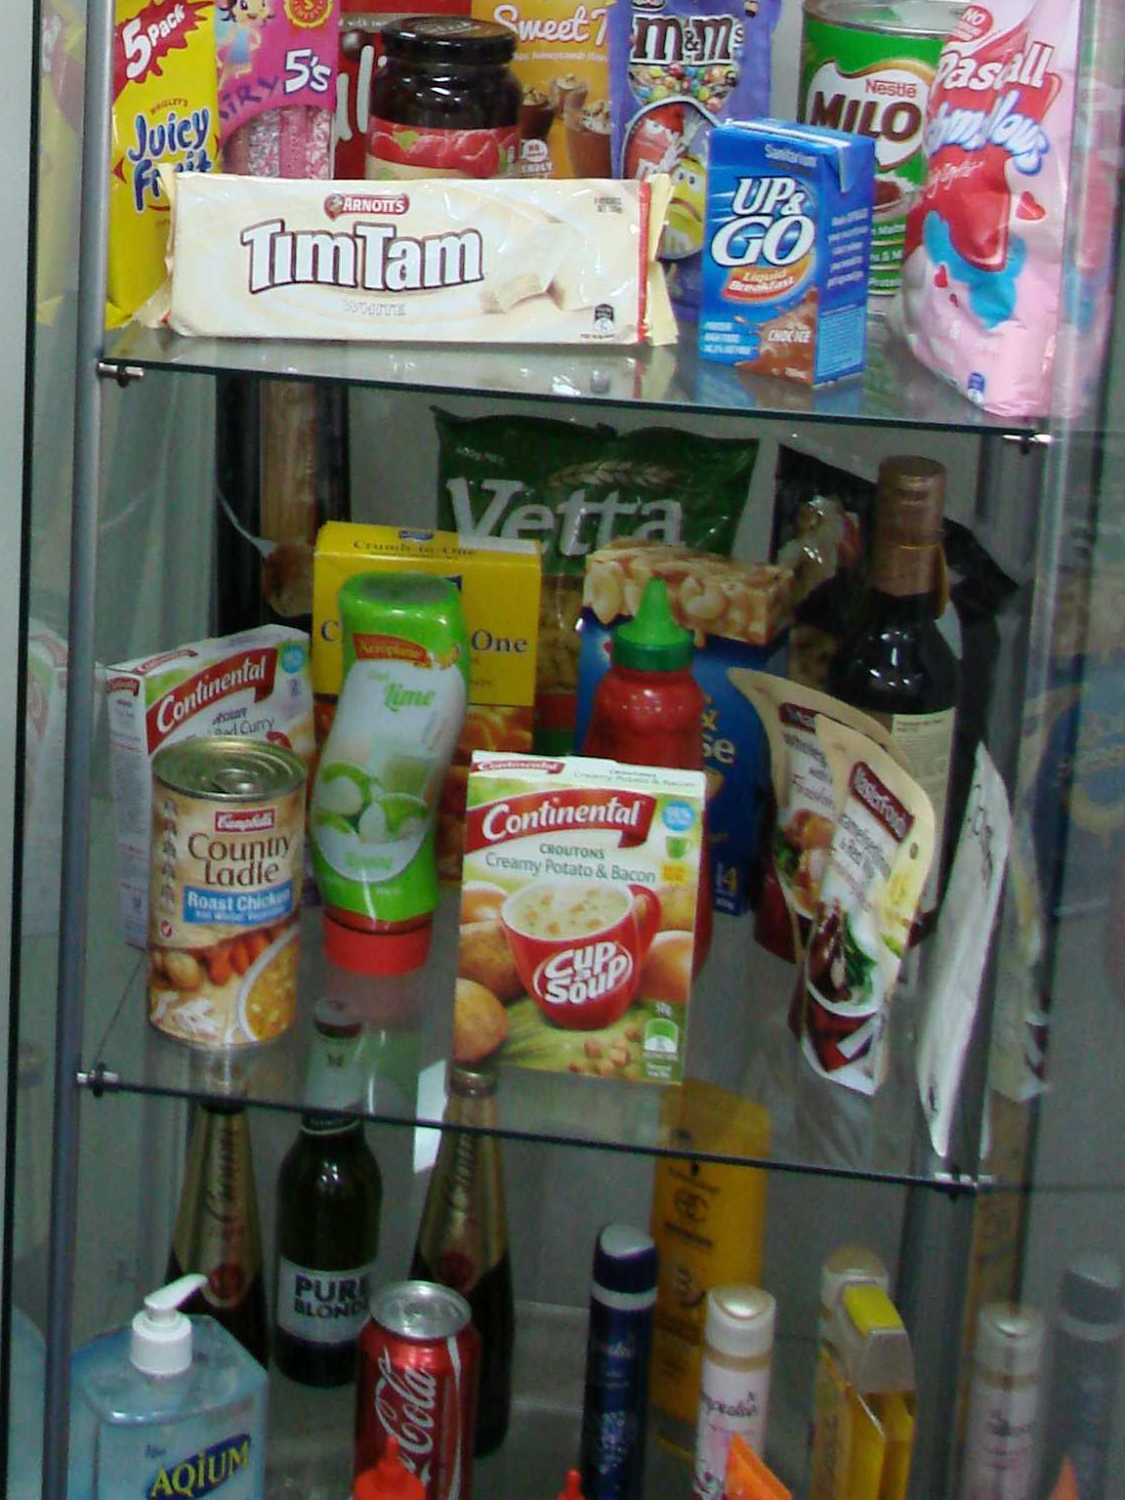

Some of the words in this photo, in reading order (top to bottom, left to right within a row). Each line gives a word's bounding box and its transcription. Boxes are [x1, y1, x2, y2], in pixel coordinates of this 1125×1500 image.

[493, 3, 590, 44] Sweet
[961, 8, 986, 27] NO
[121, 17, 153, 81] 5
[283, 48, 332, 95] 5's
[128, 107, 211, 162] Juicy
[809, 91, 923, 143] MILO
[711, 214, 816, 268] GO
[728, 275, 795, 293] Breakfast
[743, 268, 787, 284] Liquid
[445, 477, 688, 557] Vetta
[470, 628, 530, 654] One
[156, 653, 267, 734] Continental
[240, 715, 276, 736] Curry
[482, 797, 640, 842] Continental
[187, 831, 291, 862] Country
[539, 843, 606, 860] CROUTONS
[204, 858, 280, 887] Ladle
[485, 851, 542, 878] Creamy
[544, 857, 594, 879] Potato
[595, 863, 608, 879] &
[612, 862, 657, 884] Bacon
[187, 890, 235, 911] Roast
[236, 888, 292, 911] Chicken
[544, 953, 630, 1004] SOUP
[545, 942, 617, 979] CUP
[374, 1344, 437, 1455] Cola
